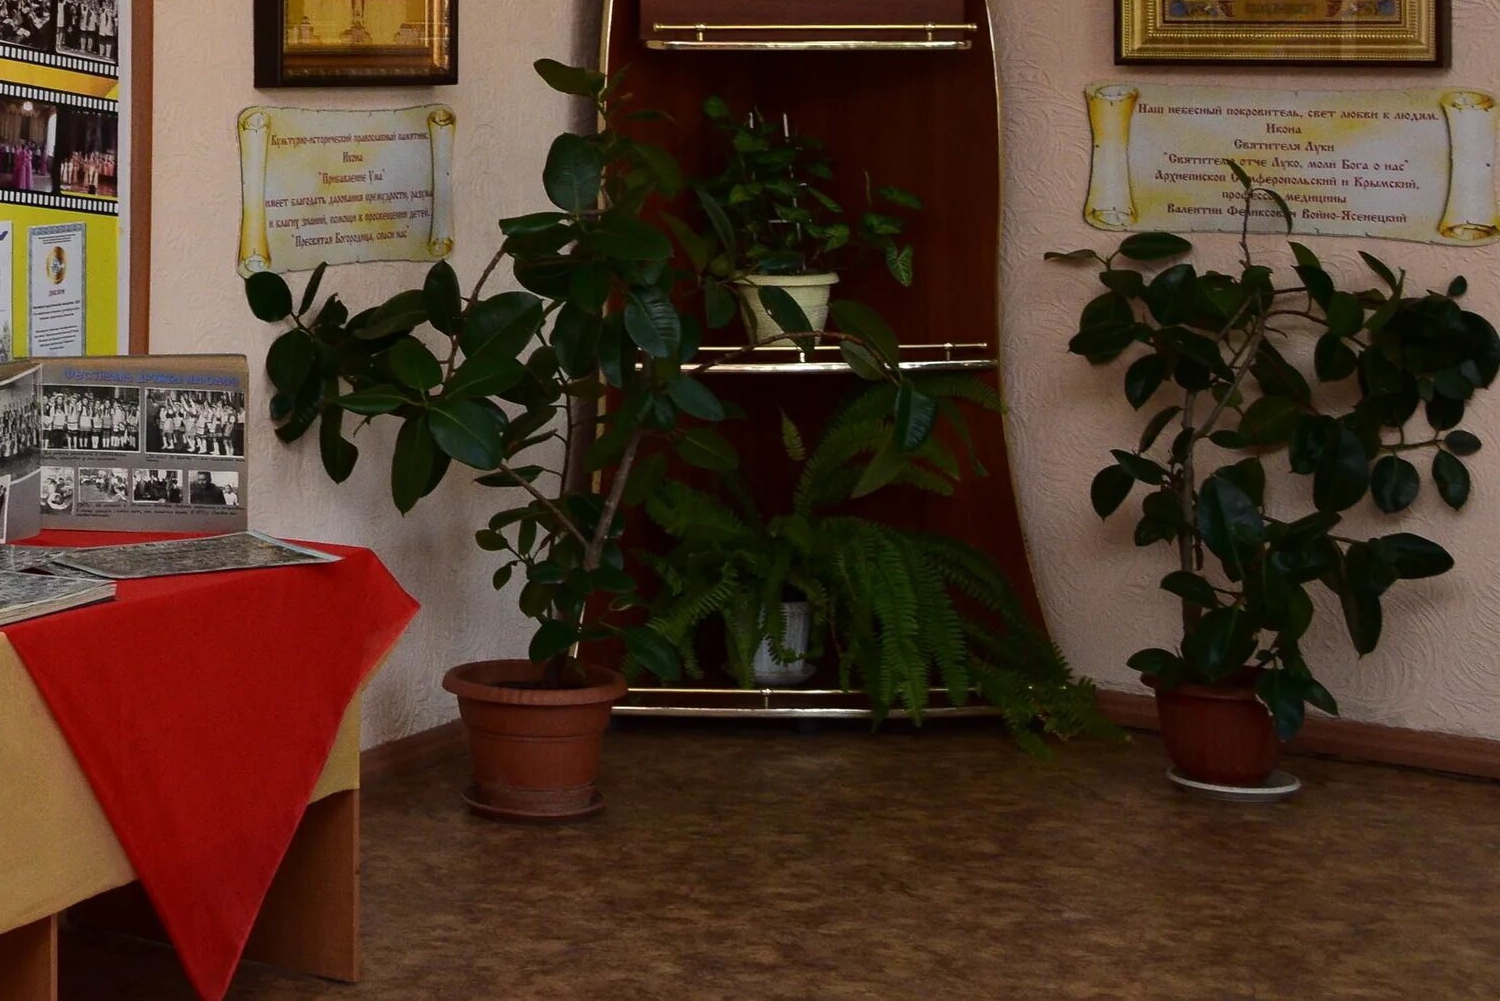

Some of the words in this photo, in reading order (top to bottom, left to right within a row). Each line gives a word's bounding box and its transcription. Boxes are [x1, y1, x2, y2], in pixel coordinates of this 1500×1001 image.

[1138, 103, 1164, 114] Наш
[1168, 106, 1222, 116] небесный
[1307, 110, 1336, 119] свет
[1266, 123, 1302, 135] Икона
[1234, 139, 1300, 151] Святителя
[1305, 141, 1335, 155] Луки
[1240, 158, 1267, 167] отче
[1307, 160, 1336, 169] моли
[1342, 159, 1369, 171] Бога
[1167, 203, 1223, 215] Валентин
